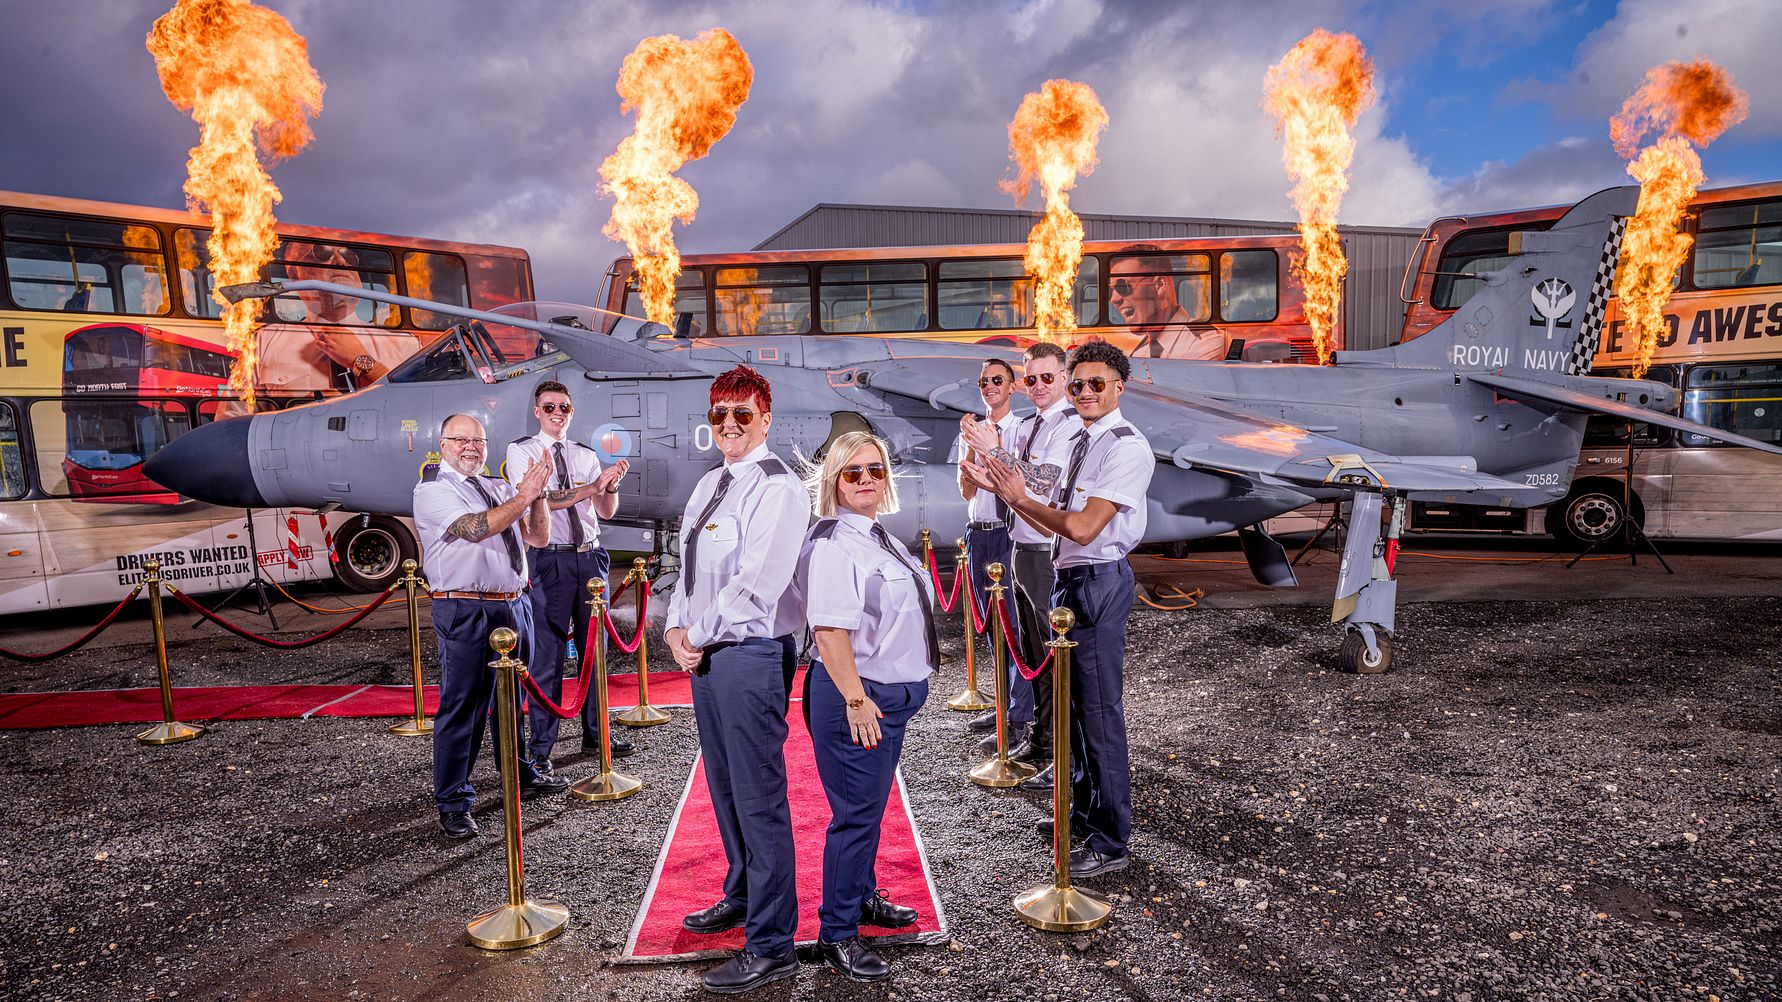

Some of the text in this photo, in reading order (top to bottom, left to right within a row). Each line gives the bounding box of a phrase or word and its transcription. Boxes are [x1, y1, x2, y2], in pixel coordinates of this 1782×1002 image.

[0, 326, 28, 368] E
[1524, 348, 1570, 372] NAVY
[1525, 473, 1559, 486] ZD582
[189, 545, 248, 564] WANTED
[257, 551, 285, 565] APPLY
[118, 562, 251, 585] ELITEUSDRIVER.CO.UK
